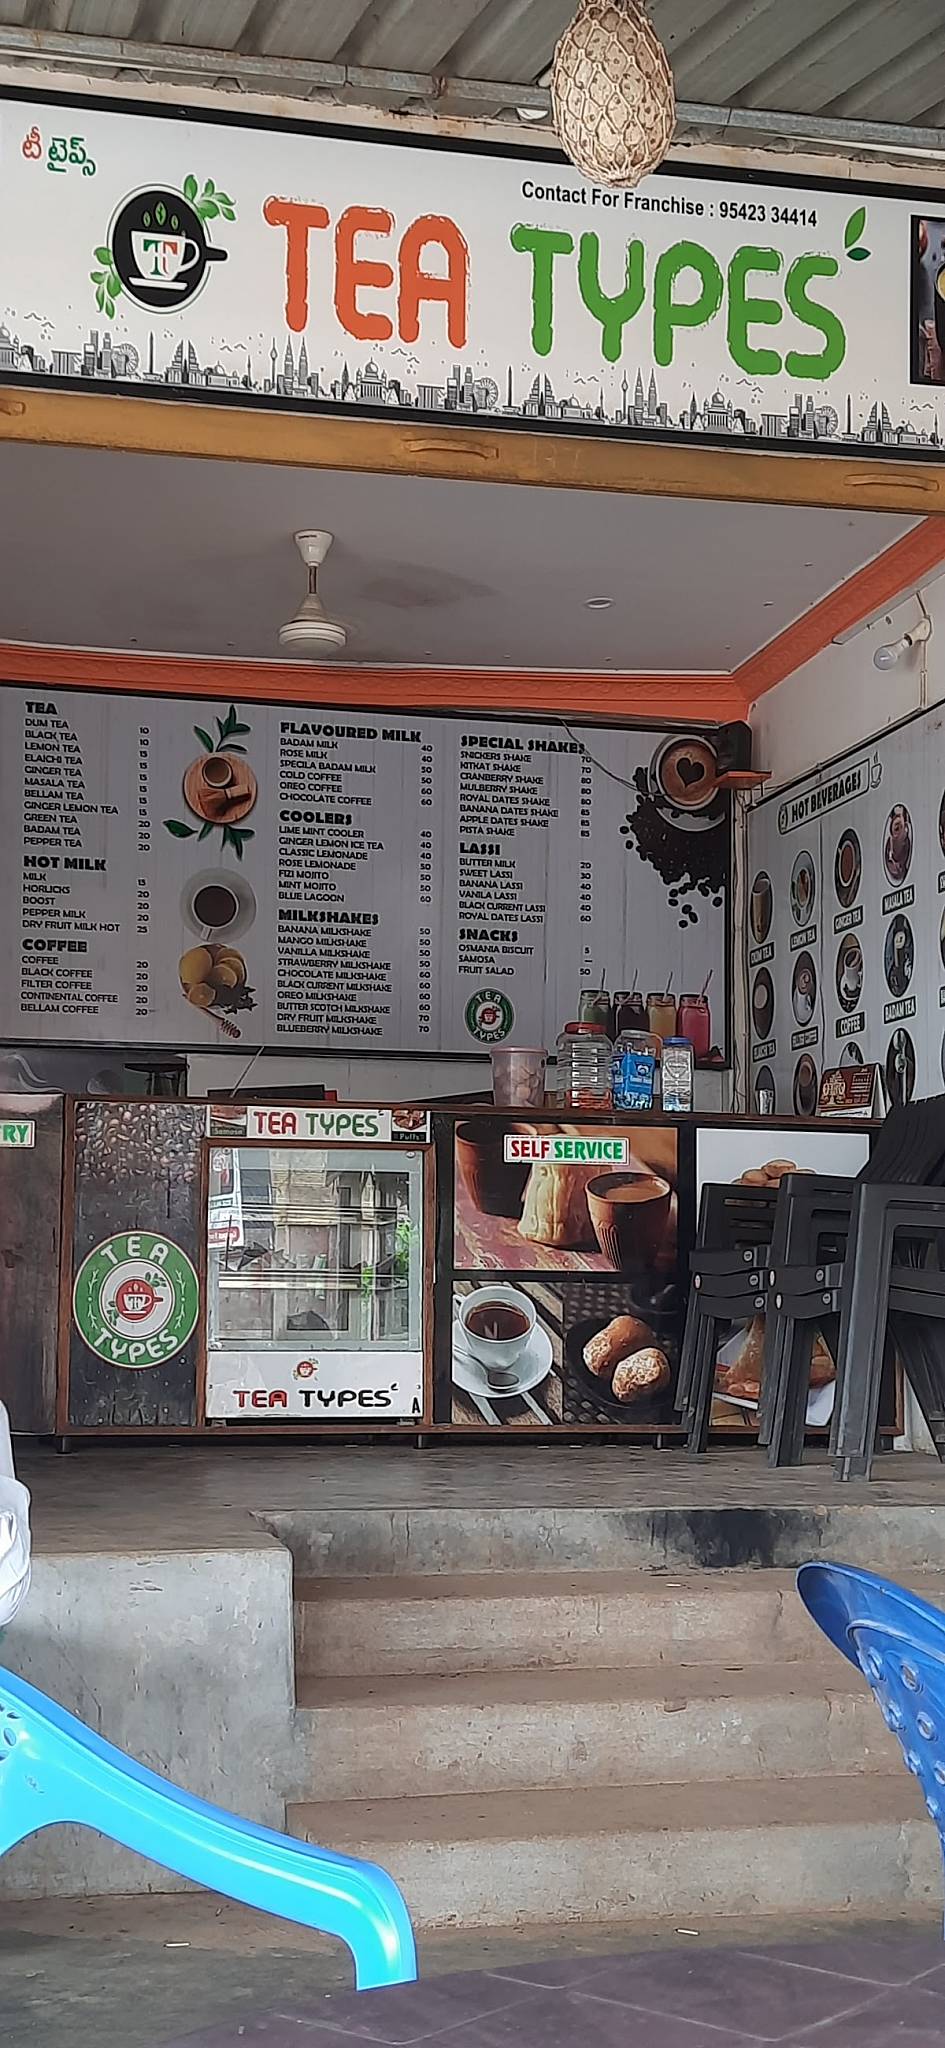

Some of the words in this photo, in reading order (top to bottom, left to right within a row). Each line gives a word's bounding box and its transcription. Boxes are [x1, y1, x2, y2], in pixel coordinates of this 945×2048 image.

[22, 126, 42, 160] టీ
[521, 181, 587, 205] Contact
[591, 189, 620, 208] For
[624, 192, 704, 216] Franchise
[709, 203, 714, 217] :
[719, 201, 767, 222] 95423
[770, 206, 818, 227] 34414
[263, 194, 470, 349] TEA
[510, 221, 847, 382] TYPES
[25, 701, 58, 715] TEA
[25, 718, 48, 728] DUM
[50, 720, 69, 729] TEA
[25, 730, 57, 741] BLACK
[58, 732, 78, 742] TEA
[280, 722, 378, 740] FLAVOURED
[382, 729, 421, 743] MILK
[24, 741, 60, 752] LEMON
[62, 744, 81, 754] TEA
[280, 738, 314, 748] BADAM
[316, 740, 338, 749] MILK
[461, 735, 524, 750] SPECIAL
[528, 739, 586, 754] SHAKES
[280, 748, 304, 758] ROSE
[306, 750, 328, 759] MILK
[24, 765, 62, 776] GINGER
[63, 768, 82, 777] TEA
[318, 762, 353, 772] BADAM
[354, 764, 376, 774] MILK
[280, 770, 306, 780] COLD
[307, 772, 342, 782] COFFEE
[24, 777, 65, 788] MASALA
[66, 780, 85, 789] TEA
[279, 781, 306, 791] OREO
[308, 783, 343, 793] COFFEE
[24, 789, 63, 799] BELLAM
[65, 791, 84, 801] TEA
[279, 792, 336, 804] CHOCOLATE
[337, 796, 372, 806] COFFEE
[460, 793, 490, 803] ROYAL
[492, 795, 520, 805] DATES
[522, 797, 550, 806] SHAKE
[791, 798, 809, 823] HOT
[811, 769, 861, 813] BEVERAGES
[24, 801, 61, 811] GINGER
[63, 803, 98, 813] LEMON
[100, 805, 119, 815] TEA
[24, 812, 57, 823] GREEN
[58, 815, 78, 824] TEA
[138, 820, 151, 828] 20
[279, 810, 352, 826] COOLERS
[24, 824, 60, 834] BADAM
[62, 827, 81, 836] TEA
[279, 826, 301, 835] LIME
[302, 827, 326, 836] MINT
[327, 828, 364, 839] COOLER
[460, 825, 484, 835] PISTA
[486, 827, 515, 836] SHAKE
[24, 836, 62, 846] PEPPER
[64, 839, 82, 848] TEA
[138, 843, 150, 851] 20
[278, 837, 314, 846] GINGER
[316, 839, 349, 848] LEMON
[350, 841, 365, 850] ICE
[366, 842, 384, 850] TEA
[460, 842, 500, 856] LASSI
[278, 848, 315, 858] CLASSIC
[316, 849, 368, 860] LEMONADE
[24, 855, 60, 869] HOT
[64, 857, 106, 871] MILK
[278, 858, 303, 868] ROSE
[304, 860, 356, 870] LEMONADE
[459, 858, 493, 867] BUTTER
[494, 860, 516, 869] MILK
[23, 872, 46, 881] MILK
[459, 868, 488, 878] SWEET
[490, 870, 513, 879] LASSI
[23, 884, 70, 894] HORLICKS
[278, 880, 302, 889] MINT
[304, 882, 337, 891] MOJITO
[459, 879, 499, 889] BANANA
[500, 881, 523, 890] LASSI
[278, 891, 303, 900] BLUE
[304, 892, 344, 902] LAGOON
[459, 890, 492, 900] VANILA
[494, 892, 517, 900] LASSI
[903, 887, 914, 905] TEA
[22, 896, 56, 906] BOOST
[137, 902, 150, 910] 20
[22, 908, 61, 918] PEPPER
[62, 910, 86, 919] MILK
[278, 909, 379, 925] MILKSHAKES
[852, 910, 862, 923] TEA
[22, 920, 43, 929] DRY
[44, 921, 72, 930] FRUIT
[74, 922, 97, 931] MILK
[99, 923, 120, 932] HOT
[278, 925, 319, 934] BANANA
[320, 927, 372, 937] MILKSHAKE
[459, 928, 518, 942] SNACKS
[807, 929, 816, 942] TEA
[22, 938, 87, 953] COFFEE
[278, 936, 314, 946] MANGO
[316, 938, 367, 948] MILKSHAKE
[22, 955, 59, 965] COFFEE
[278, 957, 339, 968] STRAWBERRY
[340, 960, 391, 970] MILKSHAKE
[458, 954, 495, 964] SAMOSA
[21, 967, 54, 977] BLACK
[56, 969, 93, 978] COFFEE
[277, 969, 334, 979] CHOCOLATE
[336, 971, 387, 981] MILKSHAKE
[458, 966, 484, 974] FRUIT
[485, 967, 515, 976] SALAD
[580, 968, 591, 976] 50
[21, 979, 53, 988] FILTER
[55, 980, 92, 990] COFFEE
[277, 991, 304, 1000] OREO
[305, 992, 357, 1002] MILKSHAKE
[475, 991, 502, 1004] TEA
[20, 1003, 60, 1013] BELLAM
[62, 1005, 99, 1014] COFFEE
[885, 1004, 904, 1022] BADAM
[904, 1001, 915, 1015] TEA
[277, 1013, 297, 1021] DRY
[298, 1014, 324, 1023] FRUIT
[326, 1014, 377, 1025] MILKSHAKE
[418, 1014, 430, 1022] 70
[840, 1018, 860, 1035] COFFEE
[473, 1026, 505, 1041] TYPES
[253, 1111, 297, 1135] TEA
[305, 1112, 378, 1137] TYPES
[0, 1125, 29, 1143] RY
[510, 1140, 550, 1159] SELF
[554, 1140, 624, 1161] SERVICE
[100, 1235, 169, 1266] TEA
[94, 1328, 178, 1363] TYPES
[232, 1389, 288, 1408] TEA
[298, 1389, 392, 1408] TYPES
[411, 1397, 421, 1414] A
